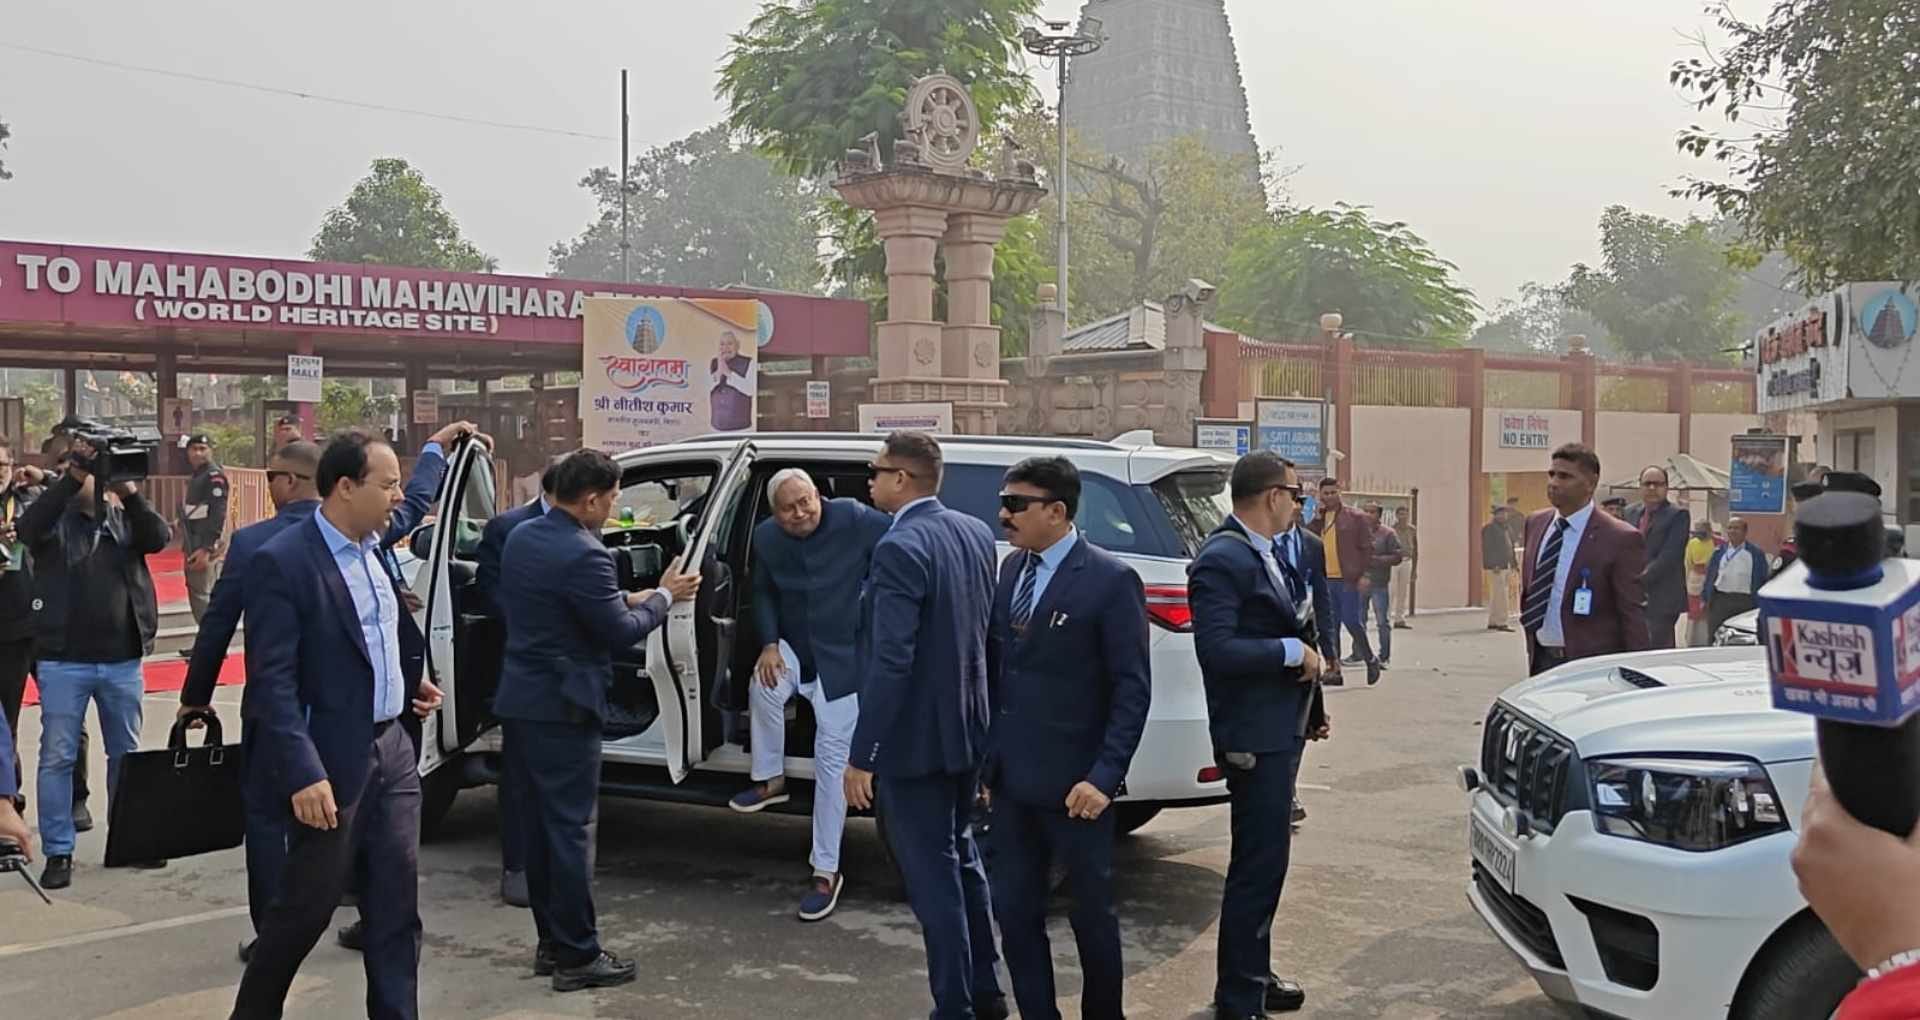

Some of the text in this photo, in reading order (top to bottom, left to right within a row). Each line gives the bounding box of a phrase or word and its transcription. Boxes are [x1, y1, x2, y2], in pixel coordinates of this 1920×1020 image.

[17, 254, 585, 319] TO MAHABODHI MAHAVIHARA
[280, 307, 420, 329] HERITAGE
[425, 314, 498, 334] SITE)
[594, 396, 693, 415] श्री नीतीश कुमार
[1503, 432, 1549, 446] NO ENTRY
[1797, 623, 1867, 650] Kashish
